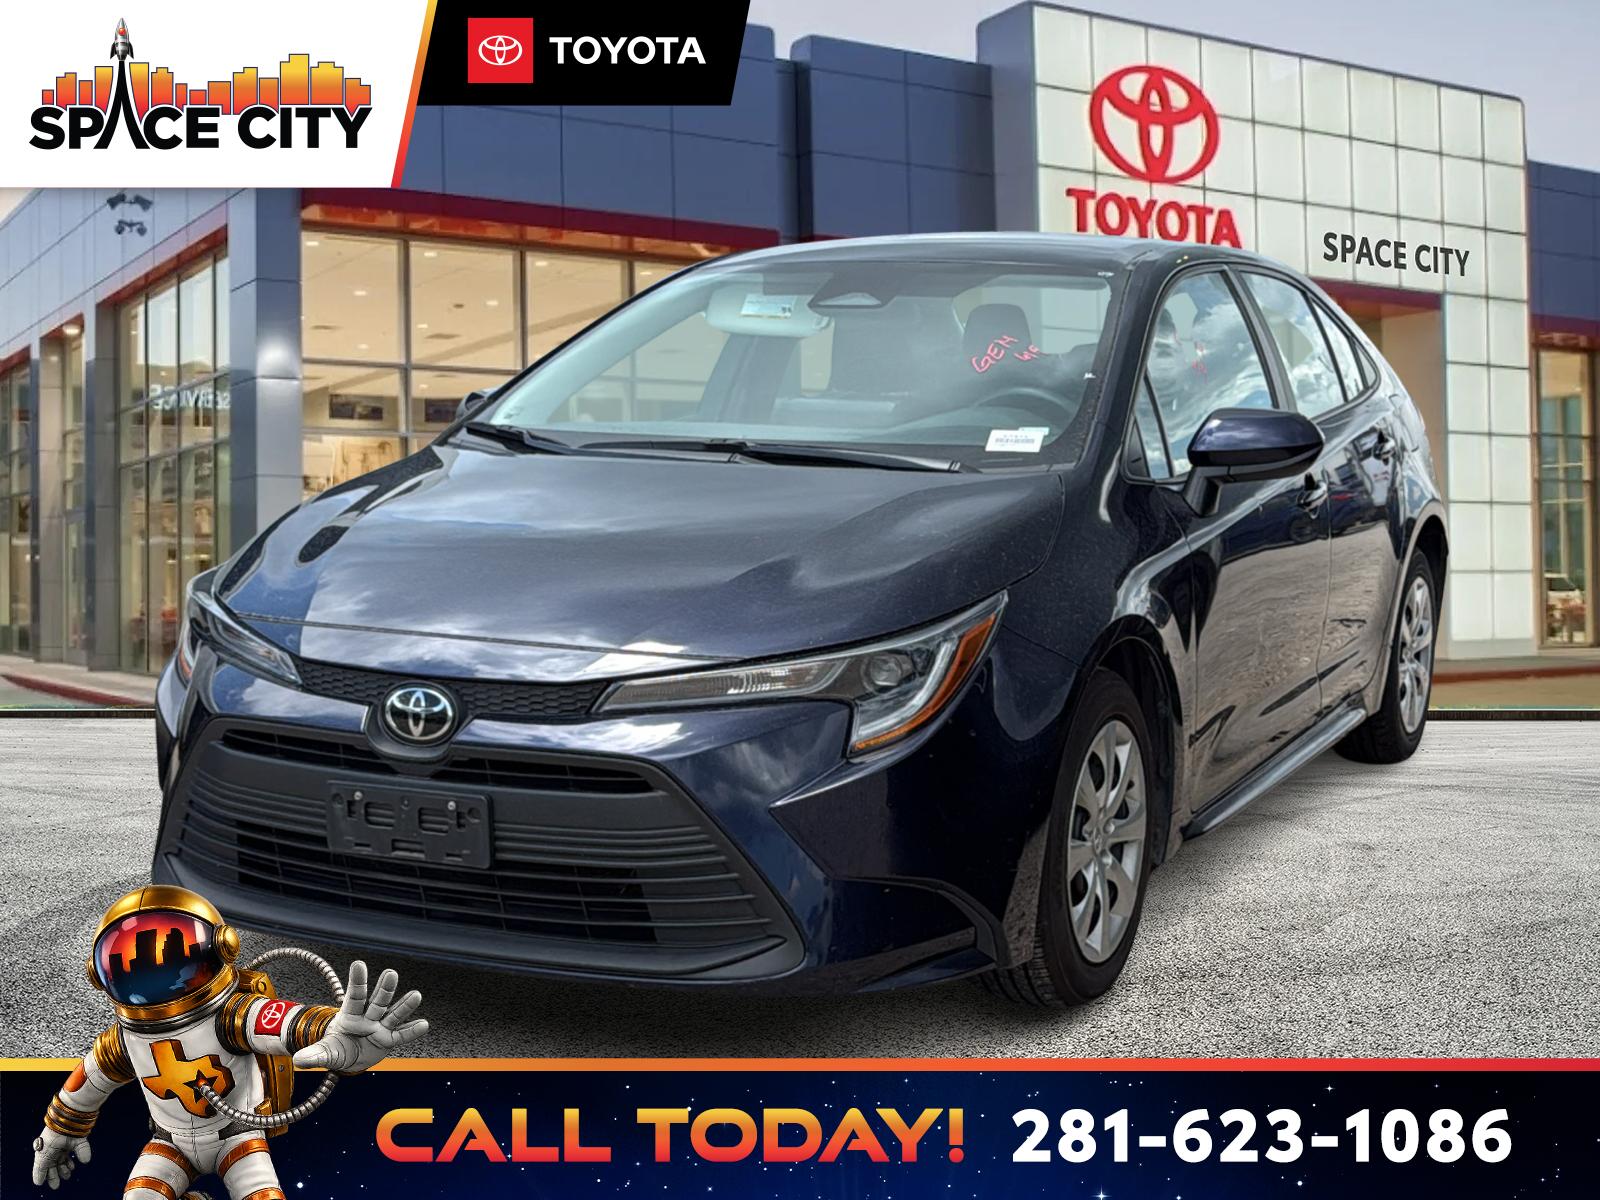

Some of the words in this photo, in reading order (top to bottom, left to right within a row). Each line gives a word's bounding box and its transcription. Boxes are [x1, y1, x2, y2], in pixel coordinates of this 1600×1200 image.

[1065, 187, 1242, 249] TOYOTA
[1322, 231, 1407, 270] SPACE
[1414, 244, 1470, 277] CITY
